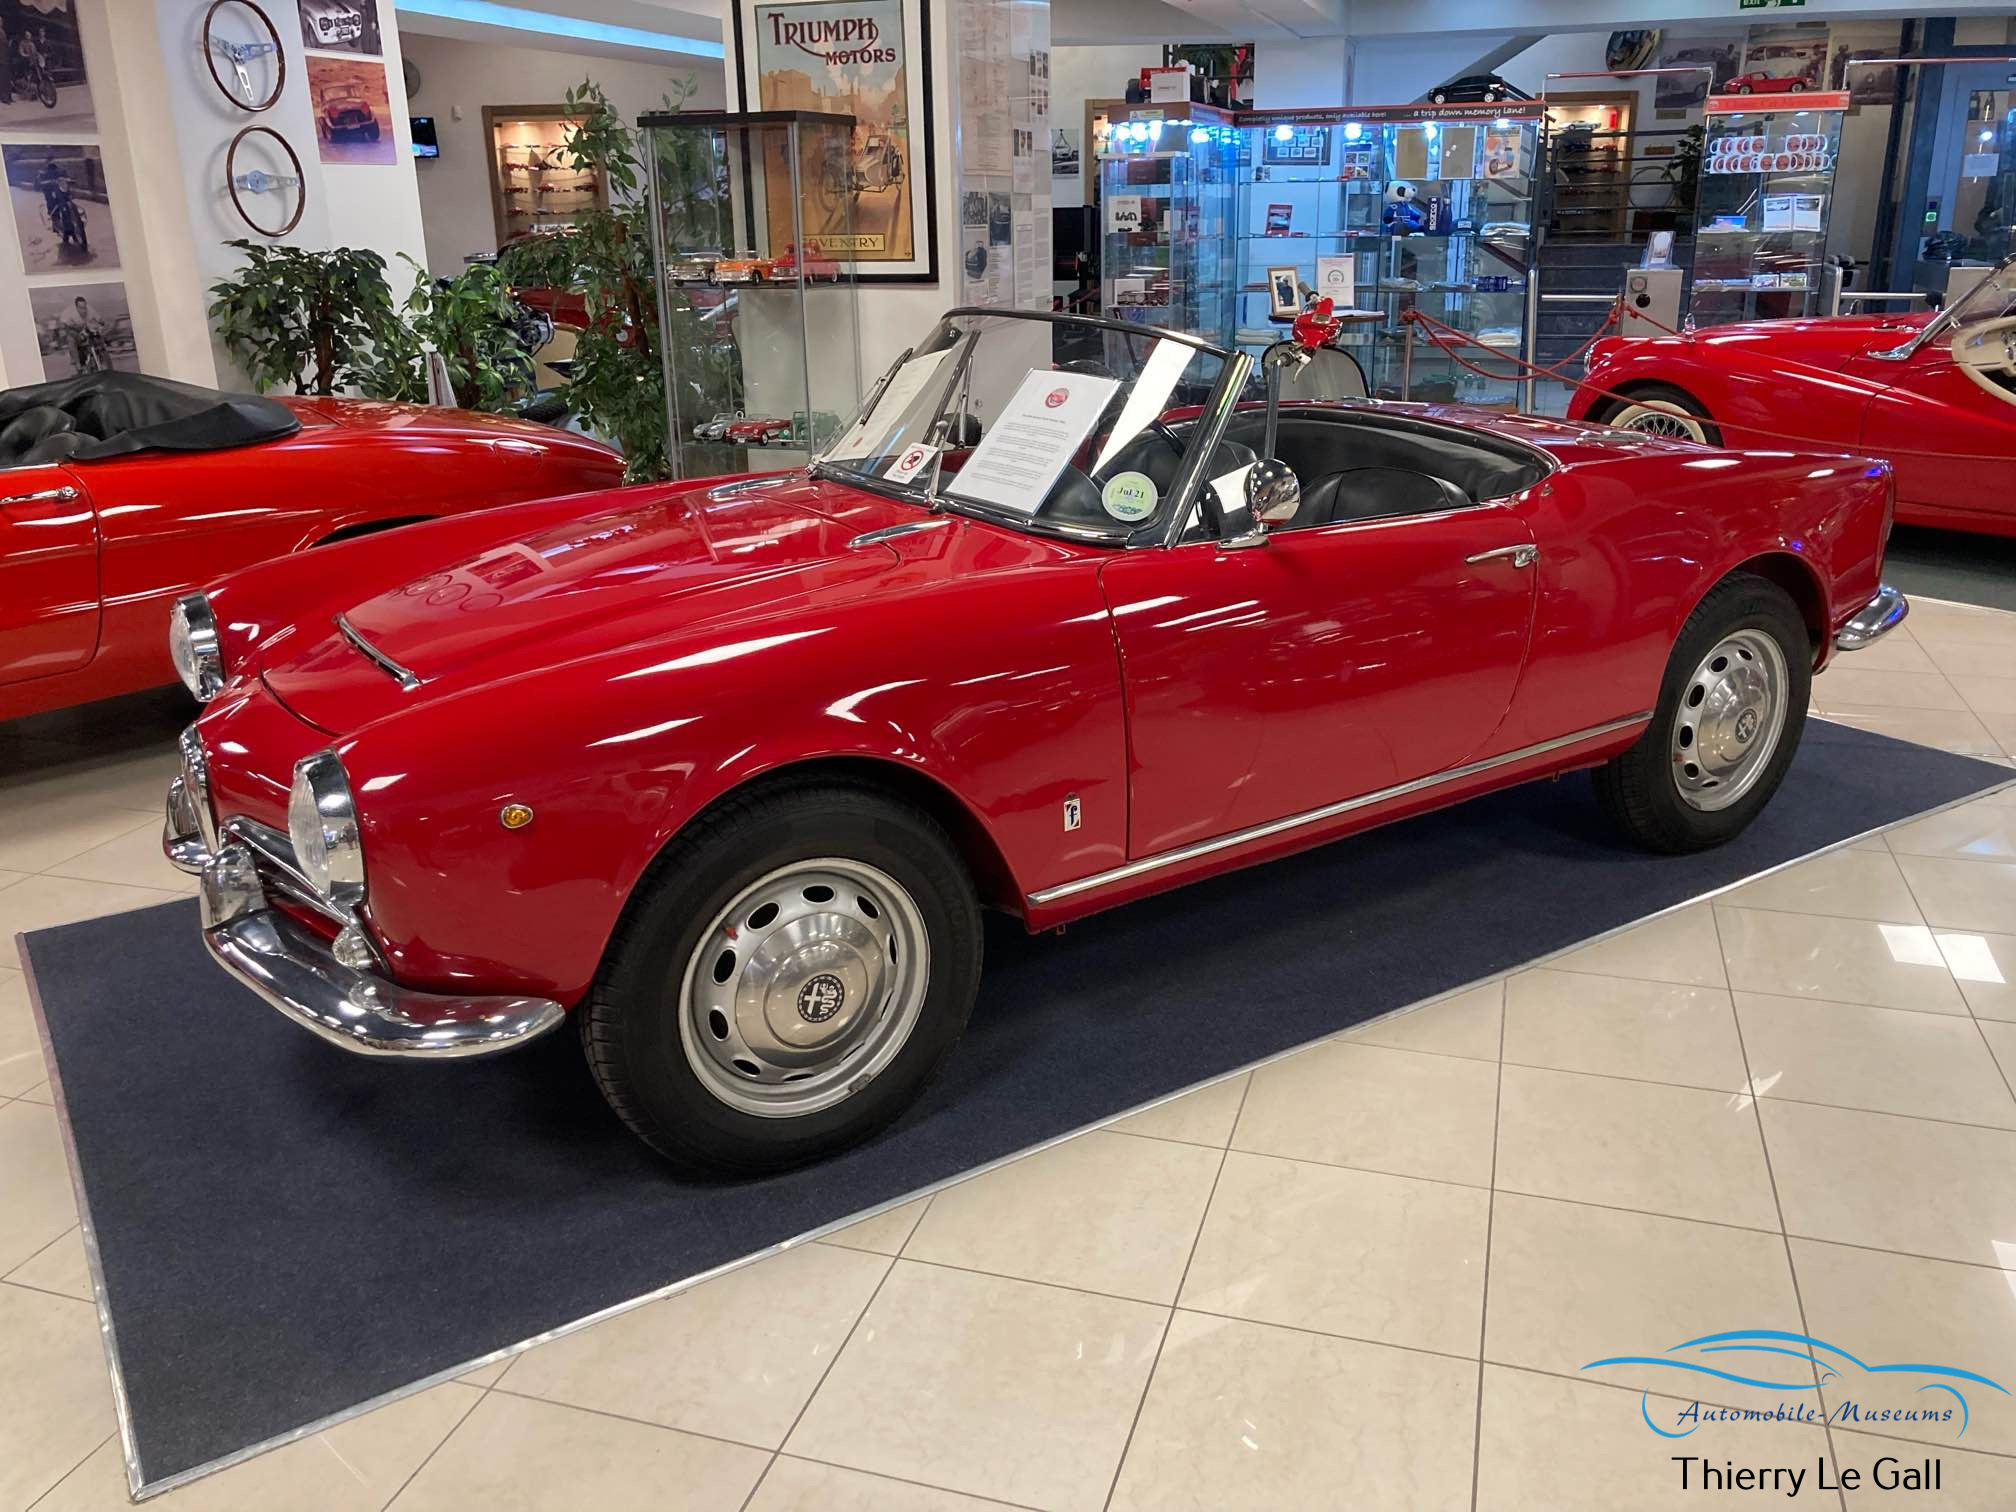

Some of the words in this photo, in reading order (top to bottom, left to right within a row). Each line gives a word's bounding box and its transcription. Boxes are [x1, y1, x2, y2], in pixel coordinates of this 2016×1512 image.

[767, 12, 879, 46] TRIUMPH
[825, 48, 896, 65] MOTORS
[1420, 108, 1437, 119] trip
[1438, 108, 1463, 116] down
[1464, 108, 1501, 119] memory
[803, 237, 879, 248] OVENTRY
[1117, 487, 1133, 496] Jul
[1134, 490, 1145, 499] 21
